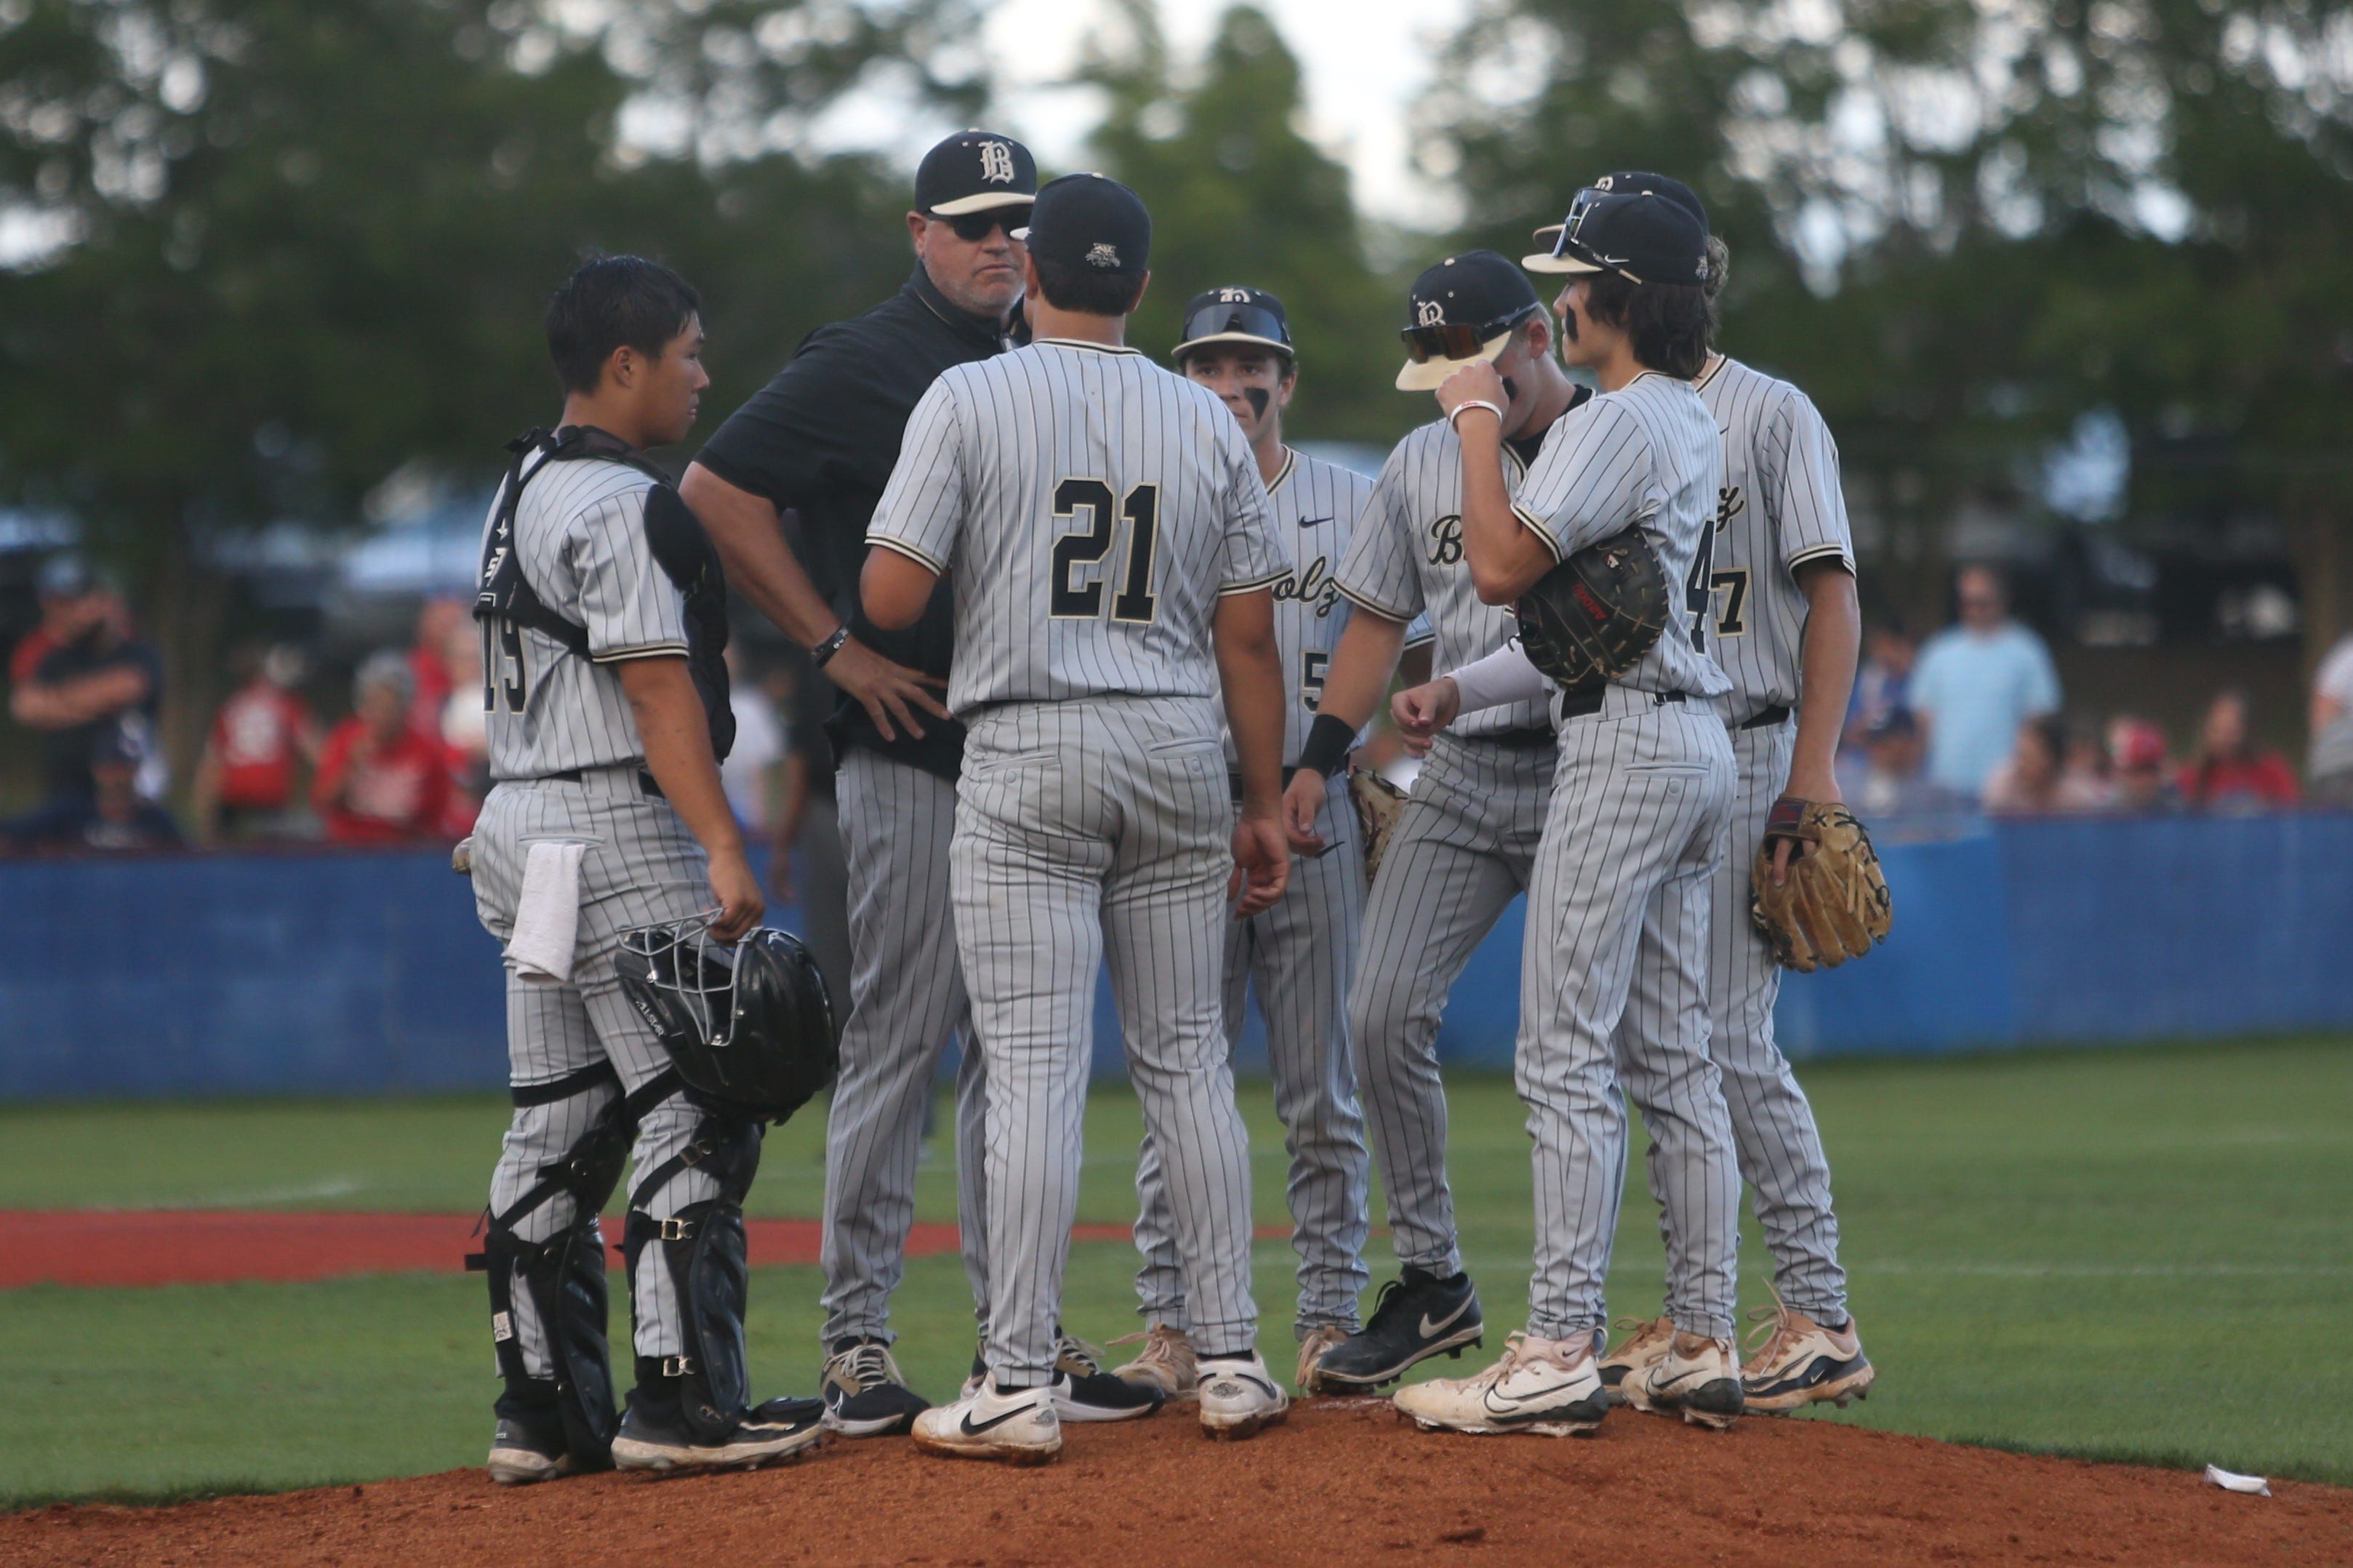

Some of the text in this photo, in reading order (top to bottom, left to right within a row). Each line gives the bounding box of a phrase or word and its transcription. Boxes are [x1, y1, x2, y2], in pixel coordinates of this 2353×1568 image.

[978, 140, 1014, 184] B
[1049, 476, 1159, 624] 21
[1428, 514, 1467, 567] B
